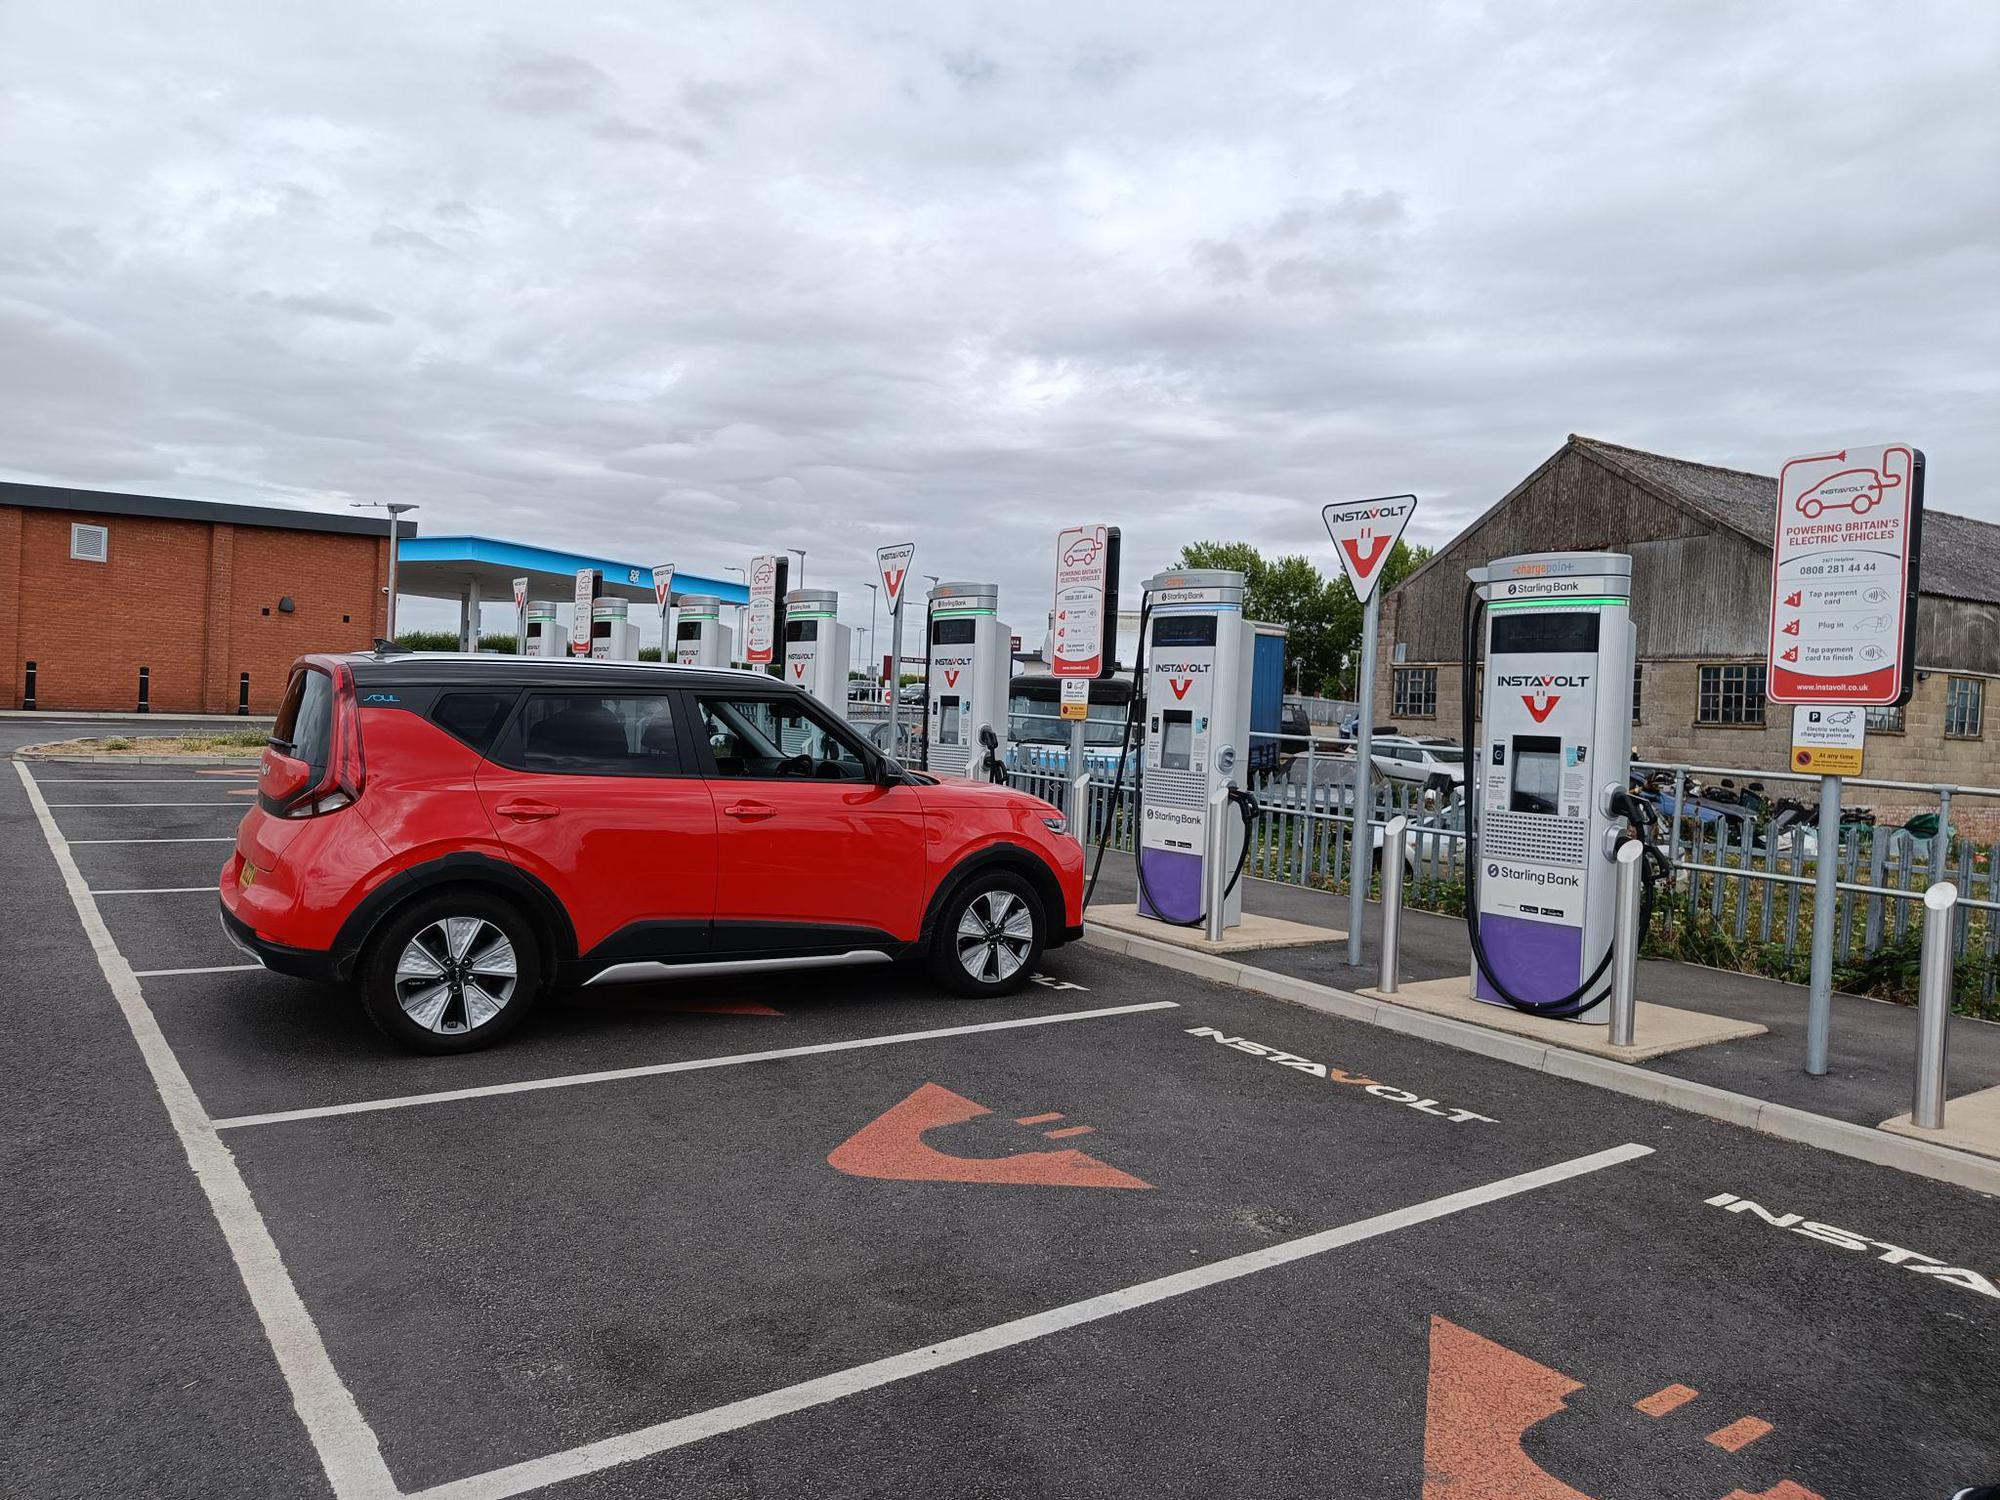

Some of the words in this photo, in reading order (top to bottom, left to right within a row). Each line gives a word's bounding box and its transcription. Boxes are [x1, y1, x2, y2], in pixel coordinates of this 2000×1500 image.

[1332, 505, 1407, 523] INSTAVOLT
[1786, 523, 1842, 536] POWERING
[1845, 519, 1899, 532] BRITAIN'S
[1789, 534, 1838, 546] ELECTRIC
[1841, 530, 1894, 543] VEHICLES
[1800, 565, 1824, 575] 0808
[1827, 564, 1844, 574] 281
[1848, 563, 1860, 572] 44
[1863, 563, 1876, 571] 44
[1518, 582, 1552, 593] Starling
[1553, 581, 1578, 592] Bank
[1809, 591, 1822, 599] Tap
[1824, 589, 1857, 598] payment
[1818, 621, 1835, 629] Plug
[1807, 646, 1819, 654] Tap
[1821, 646, 1853, 654] payment
[1155, 663, 1211, 673] INSTAVOLT
[1497, 674, 1590, 687] INSTAVOLT
[1797, 683, 1868, 692] www.instavolt.co.uk
[1154, 810, 1180, 824] Starling
[1181, 814, 1201, 825] Bank
[1501, 866, 1545, 885] Starling
[1547, 872, 1578, 887] Bank
[1183, 1025, 1501, 1124] INSTAVOLT
